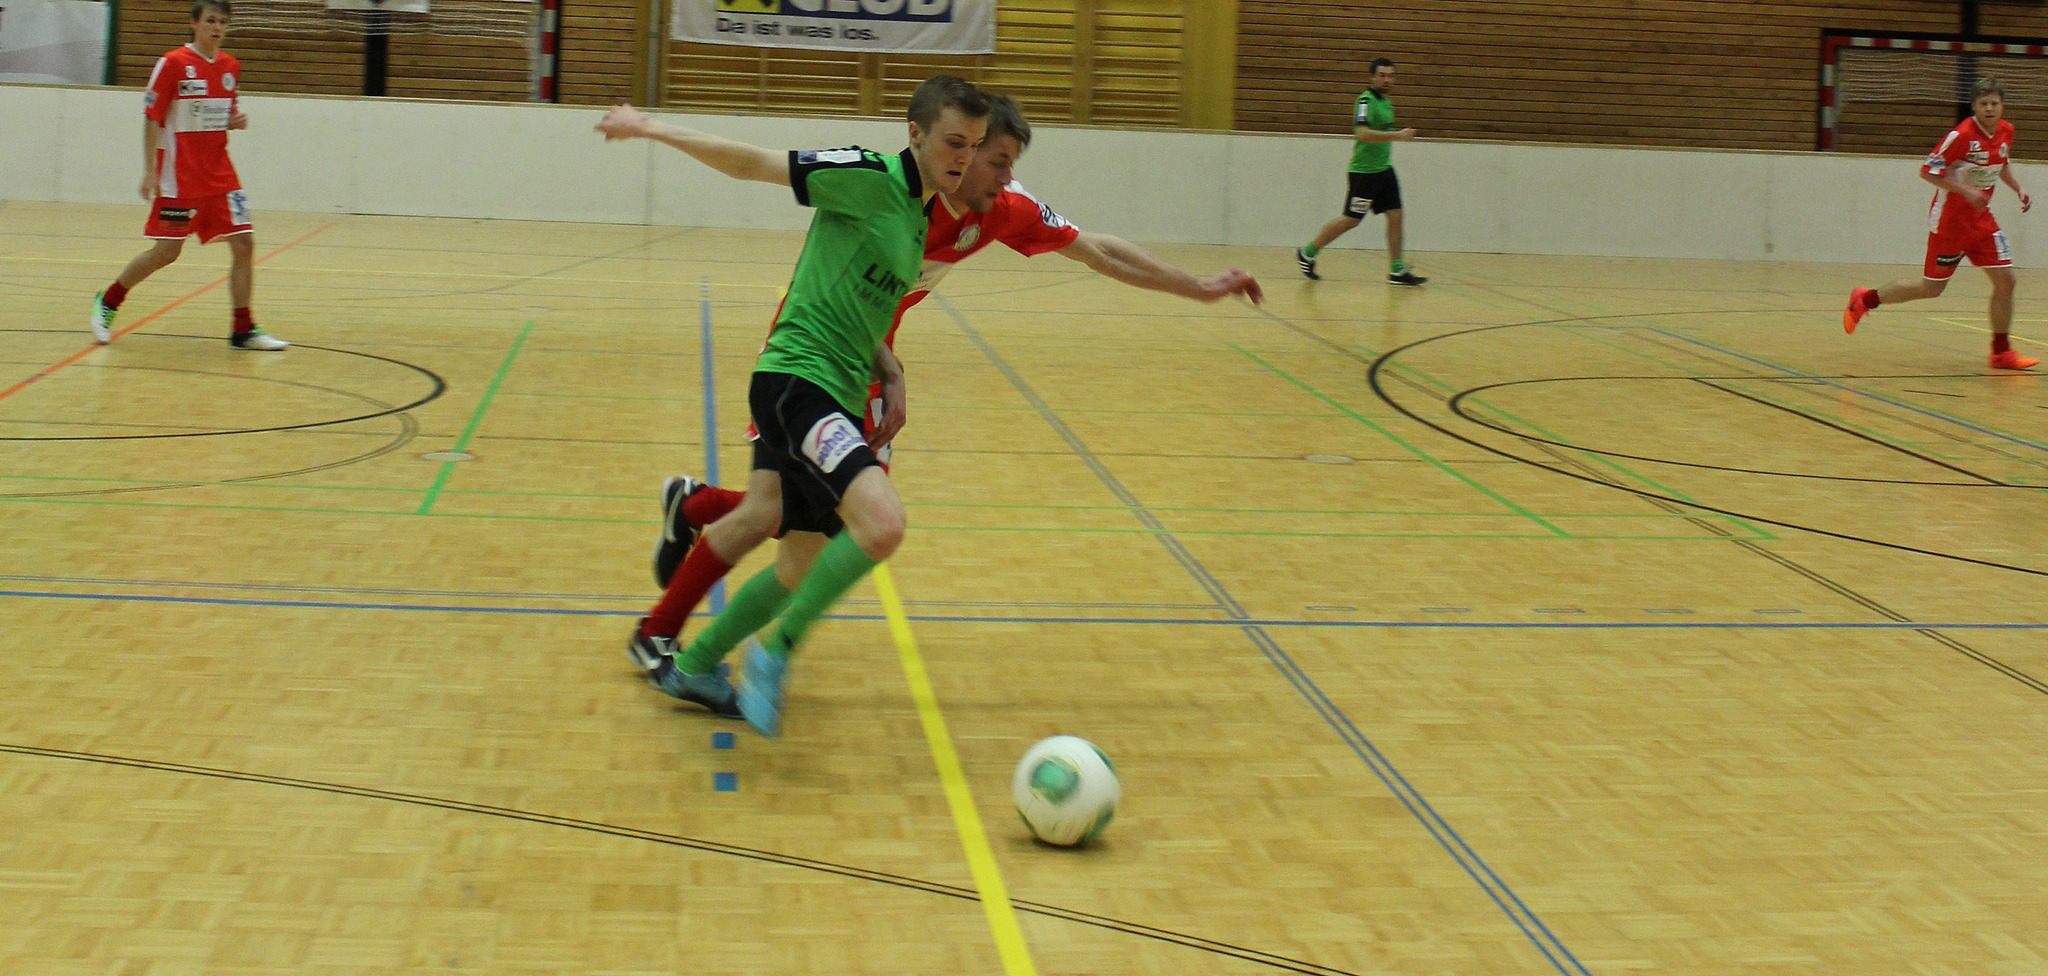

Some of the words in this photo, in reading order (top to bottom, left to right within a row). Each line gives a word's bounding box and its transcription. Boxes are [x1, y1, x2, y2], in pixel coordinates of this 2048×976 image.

[715, 17, 745, 34] Da
[752, 20, 781, 36] ist
[786, 24, 834, 39] was
[839, 25, 880, 41] los.
